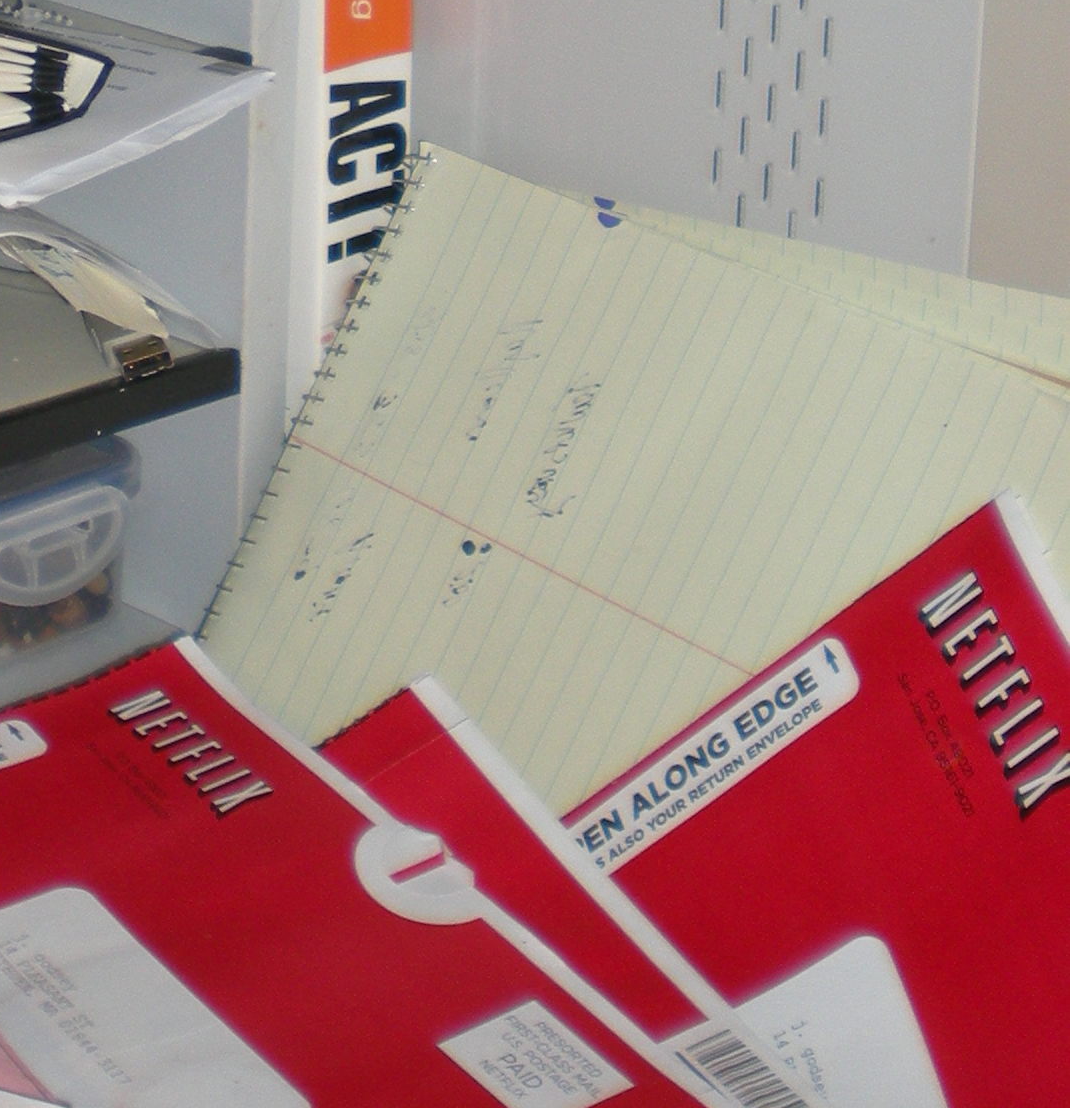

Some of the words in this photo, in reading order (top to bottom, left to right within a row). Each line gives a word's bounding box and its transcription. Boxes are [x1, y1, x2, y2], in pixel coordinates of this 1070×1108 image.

[327, 79, 407, 264] ACT!
[918, 569, 1070, 814] NETFLIX
[108, 690, 274, 815] NETFLIX
[607, 828, 645, 862] ALSO
[646, 799, 687, 832] YOUR
[688, 756, 746, 804] RETURN
[746, 698, 823, 761] ENVELOPE
[631, 732, 731, 821] ALONG
[733, 667, 819, 741] EDGE
[479, 1059, 529, 1101] NETFLIX
[498, 1053, 543, 1089] PAID
[524, 1049, 578, 1095] POSTAGE
[535, 1021, 603, 1079] PRESORTED
[575, 1073, 601, 1098] MAIL
